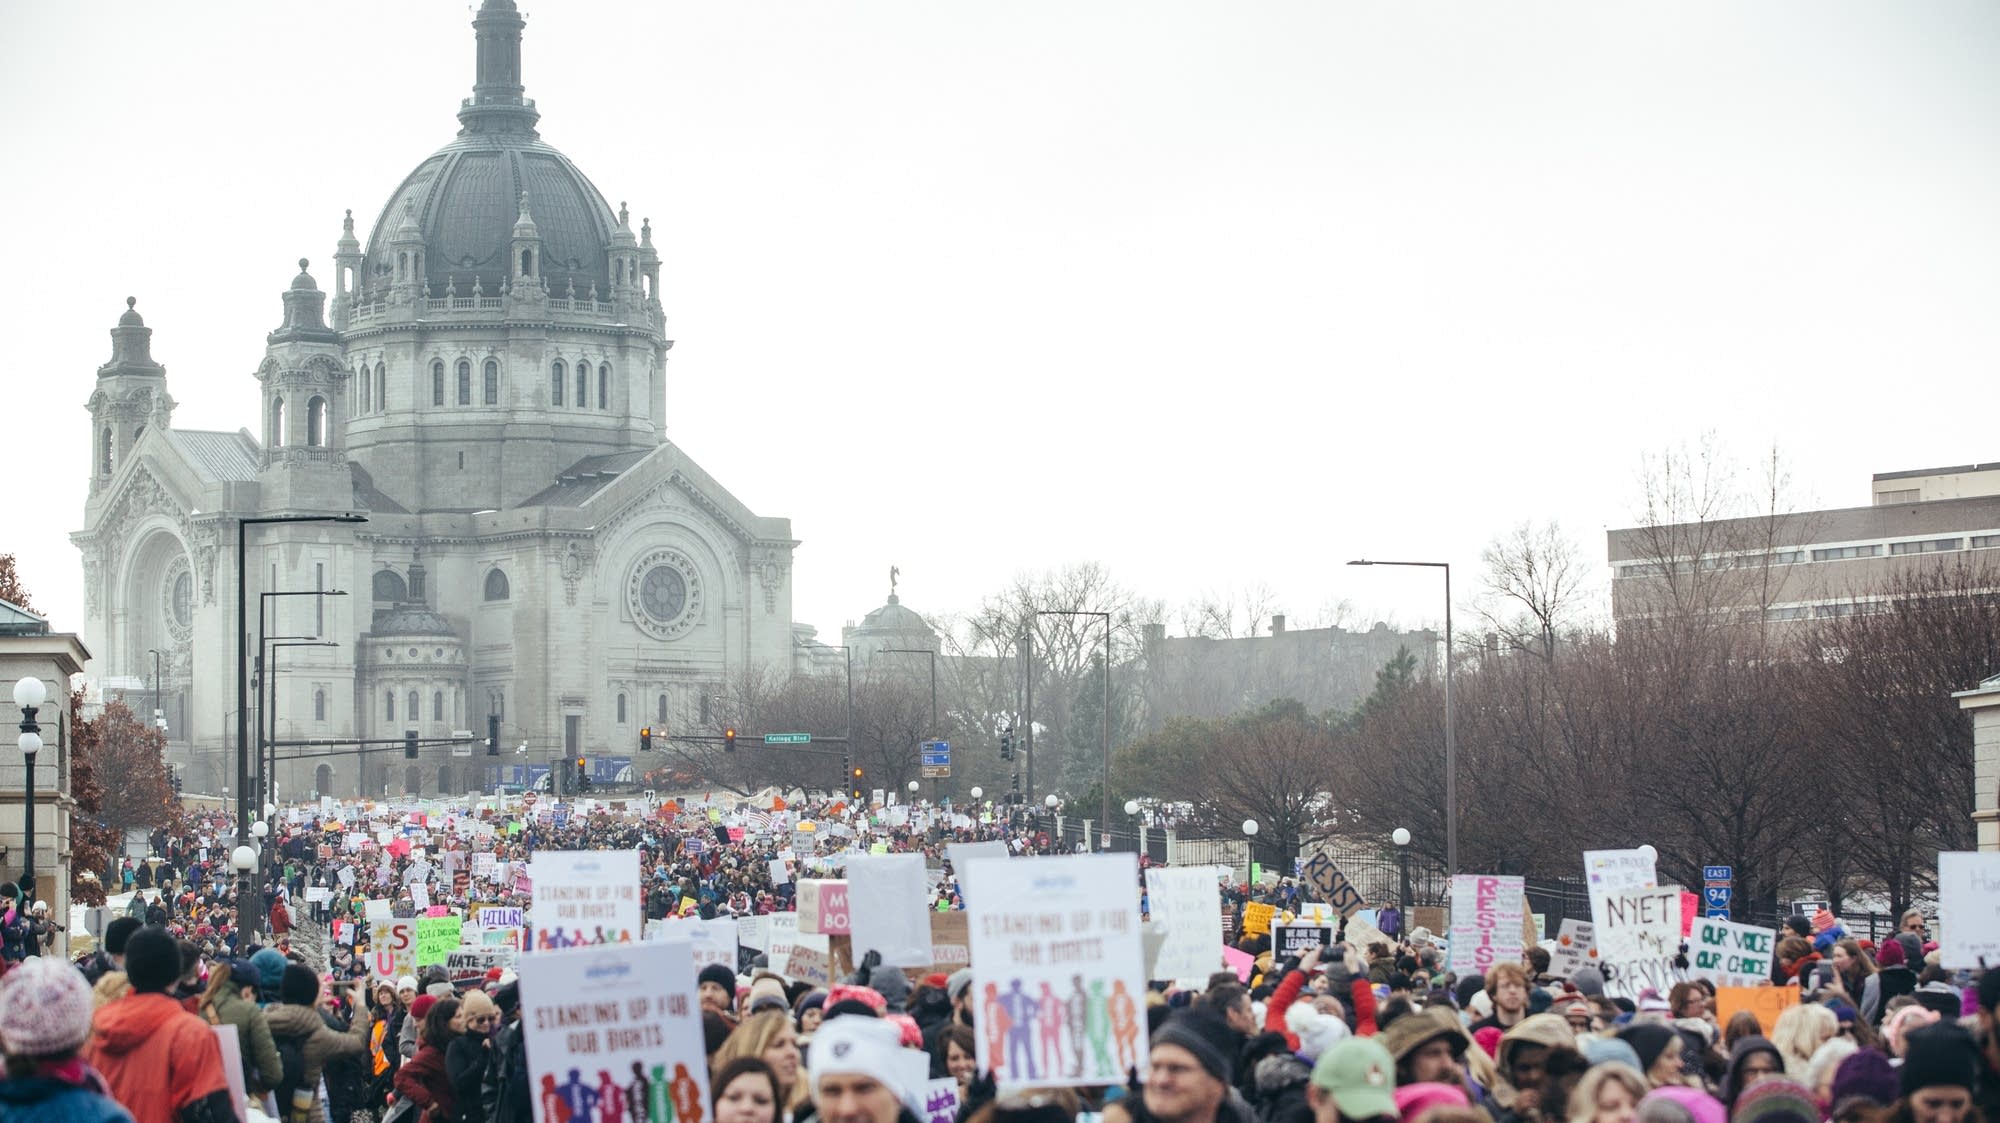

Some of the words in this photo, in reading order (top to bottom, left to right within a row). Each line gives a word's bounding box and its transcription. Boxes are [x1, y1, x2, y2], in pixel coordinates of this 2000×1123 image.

[768, 735, 791, 743] Kellogg
[1707, 869, 1727, 878] EAST
[1304, 852, 1364, 914] RESIST
[539, 885, 592, 901] STANDING
[596, 885, 609, 900] UP
[614, 885, 633, 900] FOR
[1708, 888, 1728, 902] 94
[483, 909, 522, 926] HILLARY
[558, 903, 577, 918] OUR
[581, 903, 617, 919] RIGHTS
[1606, 894, 1674, 928] NYET
[824, 912, 850, 929] BO
[981, 912, 1064, 938] STANDING
[1071, 911, 1090, 932] UP
[1100, 909, 1128, 934] FOR
[1285, 929, 1295, 937] WE
[1296, 929, 1308, 938] ARE
[1309, 929, 1321, 938] THE
[1702, 924, 1728, 948] OUR
[1733, 930, 1771, 953] VOICE
[1011, 941, 1042, 965] OUR
[1050, 937, 1105, 963] RIGHTS
[1286, 938, 1321, 950] LEADERS
[448, 955, 480, 968] HATE
[486, 954, 494, 963] IS
[1696, 950, 1721, 970] OUR
[1728, 955, 1768, 976] CHOICE
[535, 1001, 620, 1031] STANDING
[628, 997, 650, 1021] UP
[657, 992, 688, 1017] FOR
[567, 1030, 599, 1055] OUR
[606, 1024, 664, 1053] RIGHTS
